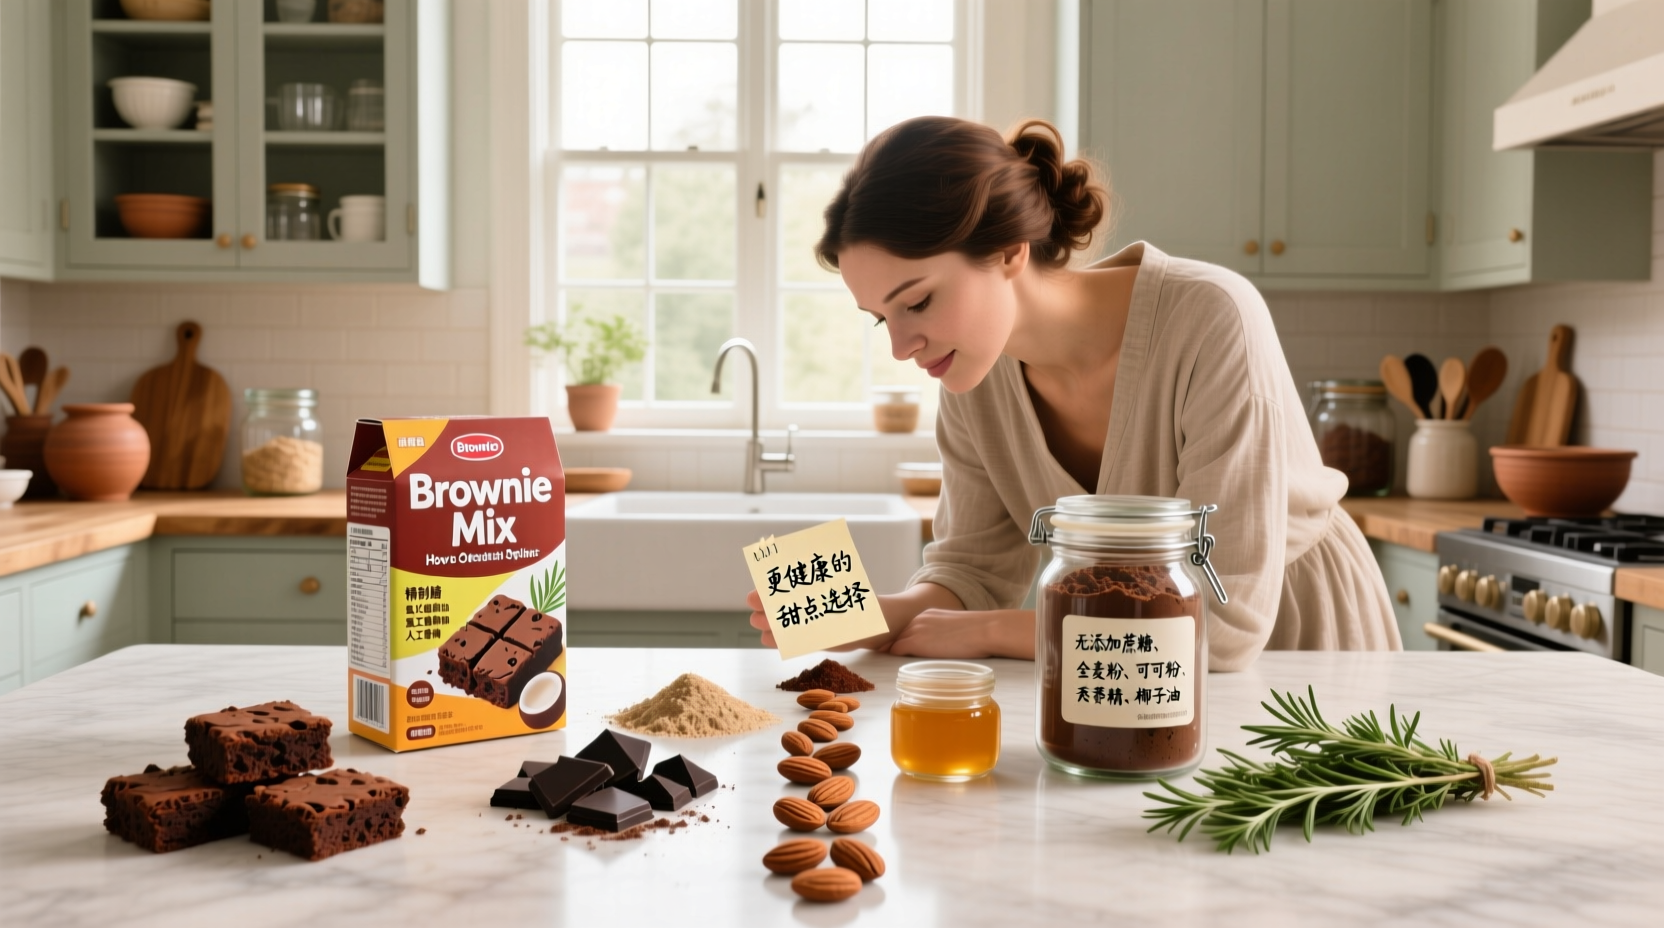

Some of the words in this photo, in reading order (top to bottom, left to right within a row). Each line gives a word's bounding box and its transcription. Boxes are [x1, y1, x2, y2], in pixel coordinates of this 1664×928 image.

[409, 467, 552, 509] Brownie
[452, 508, 517, 547] Mix
[766, 550, 852, 597] 更健康的
[776, 581, 870, 628] 甜点选择
